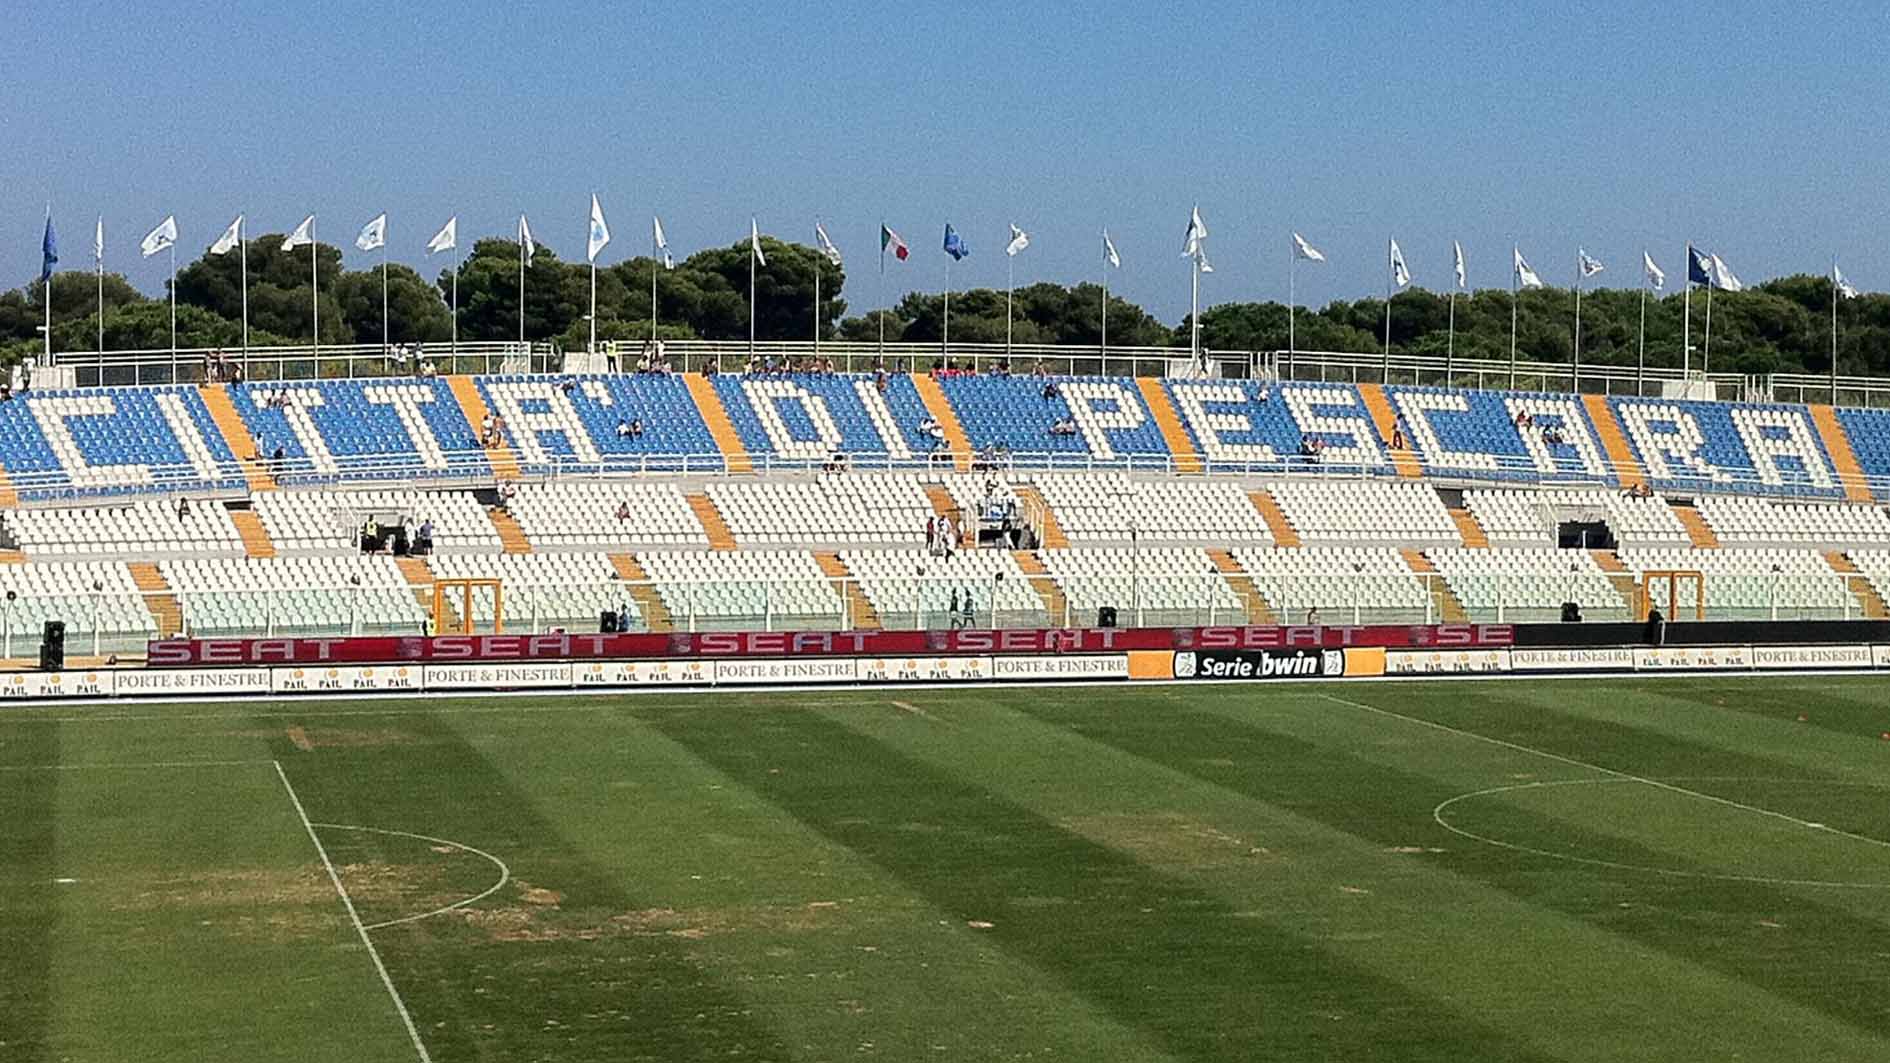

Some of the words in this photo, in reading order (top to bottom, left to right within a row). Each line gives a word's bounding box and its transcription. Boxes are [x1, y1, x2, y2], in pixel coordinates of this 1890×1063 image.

[742, 379, 913, 460] DI
[1058, 382, 1834, 488] PESCARA
[431, 634, 619, 657] SEAT
[700, 631, 880, 653] SEAT
[956, 628, 1128, 650] SEAT
[1201, 626, 1365, 646] SEAT
[150, 639, 345, 663] SEAT
[1514, 651, 1554, 664] PORTE
[1569, 650, 1631, 663] FINESTRE
[1756, 651, 1798, 663] PORTE
[1810, 649, 1869, 662] FINESTRE
[719, 665, 767, 678] PORTE
[784, 663, 853, 677] FINESTRE
[997, 661, 1046, 674] PORTE
[1060, 660, 1127, 673] FINESTRE
[1201, 657, 1253, 676] Serie
[1261, 651, 1317, 675] bwin
[118, 675, 172, 688] PORTE
[192, 672, 269, 687] FINESTRE
[427, 670, 477, 683] PORTE
[495, 668, 569, 682] FINESTRE
